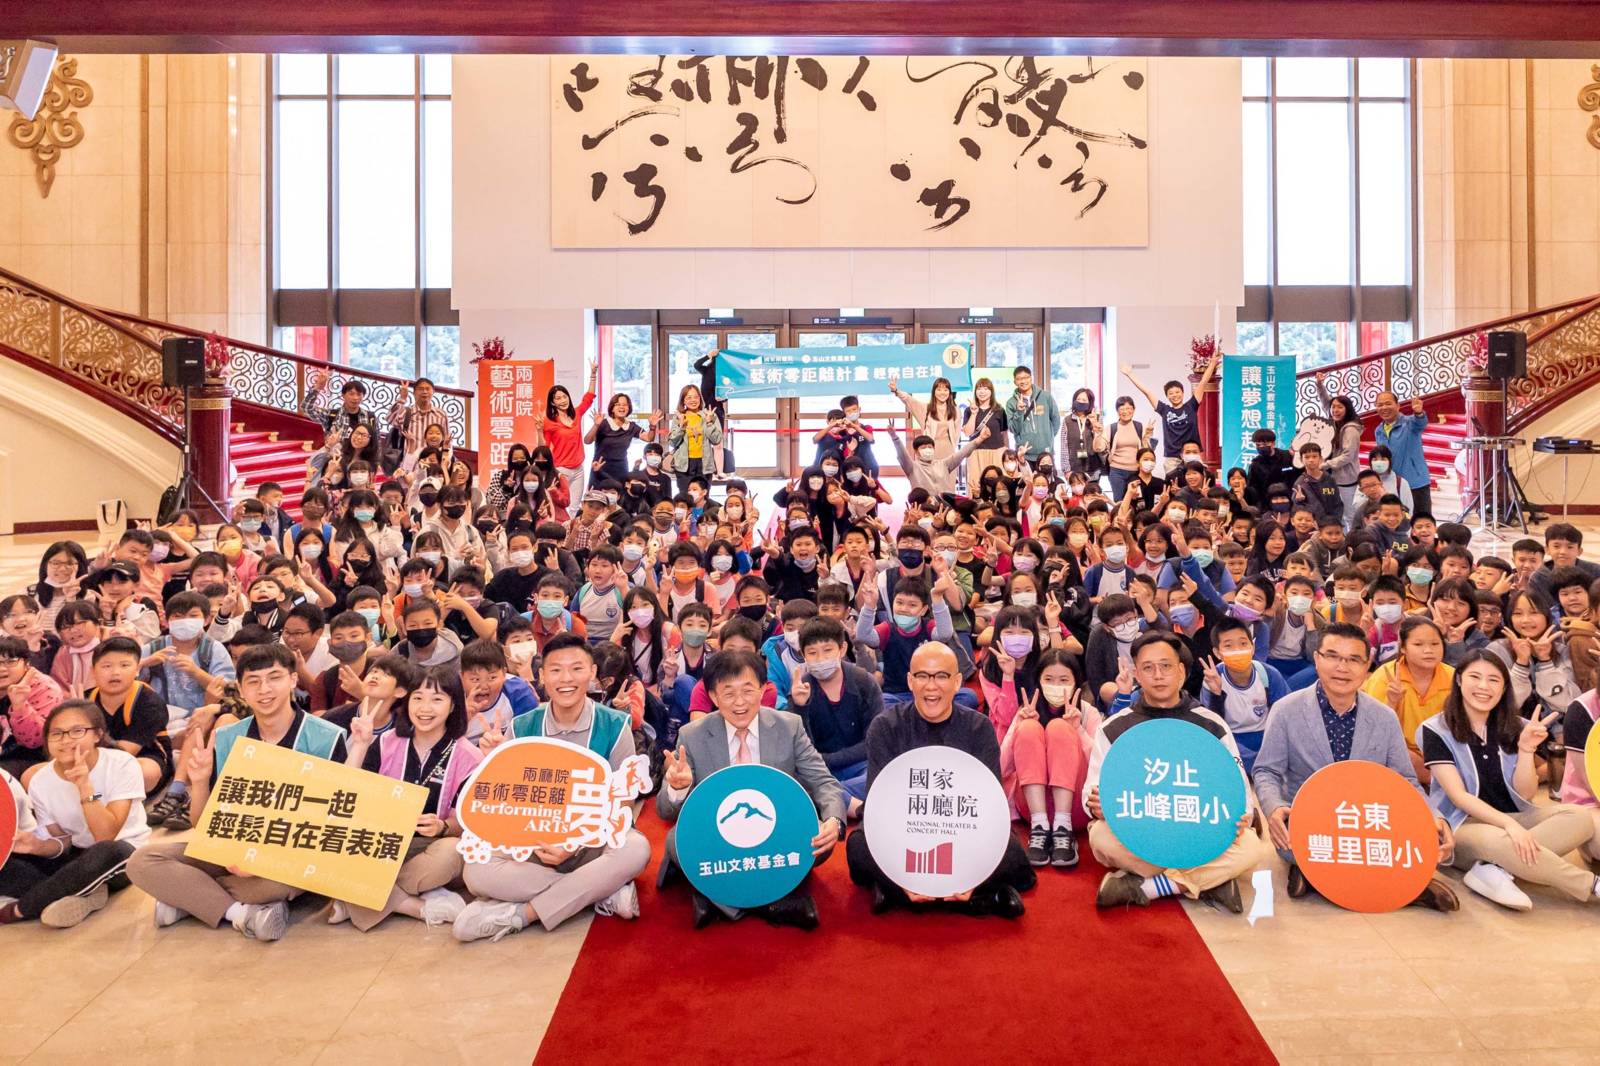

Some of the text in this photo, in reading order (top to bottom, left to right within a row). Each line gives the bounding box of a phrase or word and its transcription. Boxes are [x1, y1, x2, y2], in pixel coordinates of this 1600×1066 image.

[515, 365, 533, 417] 兩廳院
[490, 365, 514, 480] 藝術零距
[523, 767, 570, 785] 兩廳院
[908, 767, 954, 790] 國家
[1143, 757, 1201, 789] 汐止
[216, 775, 358, 820] 讓我們一起
[473, 781, 566, 805] 藝術零距離
[908, 793, 979, 818] 兩廳院
[470, 800, 563, 823] Performing
[1115, 790, 1231, 825] 北峰國小
[1334, 800, 1392, 832] 台東
[206, 810, 404, 862] 輕鬆自在看表演
[906, 820, 940, 828] NATIONAL
[906, 827, 938, 835] CONCERT
[699, 851, 801, 876] 玉山文教基金會
[1307, 834, 1424, 869] 豐里國小
